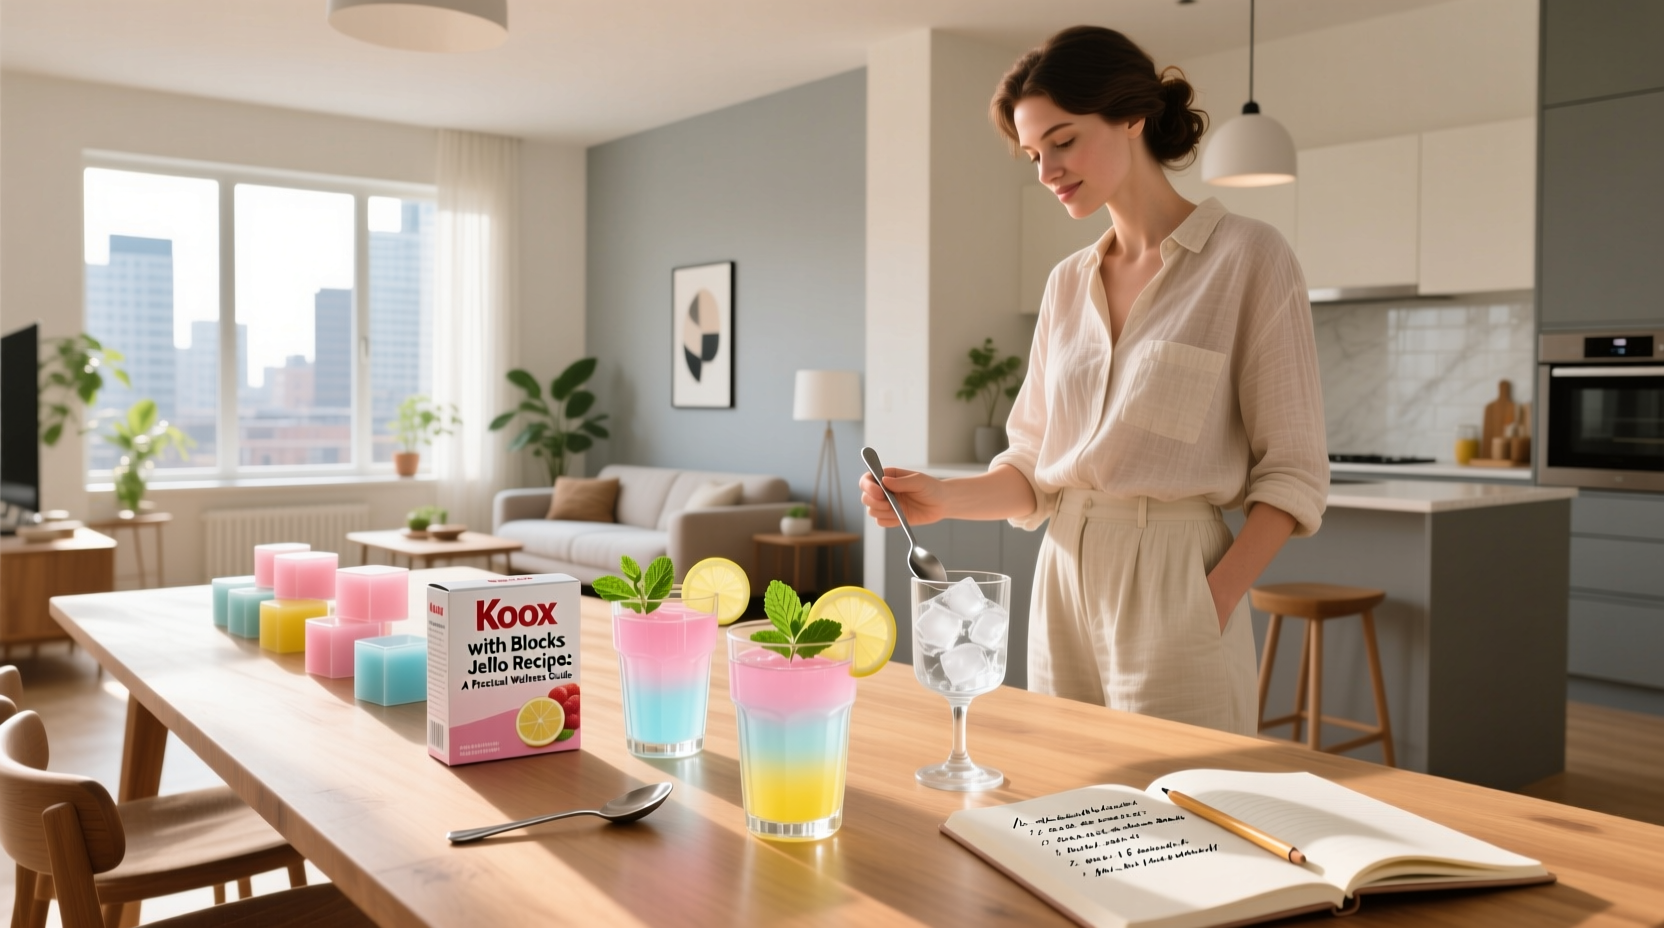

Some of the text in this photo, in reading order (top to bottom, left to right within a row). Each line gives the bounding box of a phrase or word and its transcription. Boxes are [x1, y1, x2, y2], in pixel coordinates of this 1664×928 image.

[476, 598, 558, 631] Koox
[467, 632, 566, 656] with Blocks
[467, 656, 509, 675] Jello
[461, 680, 469, 691] A
